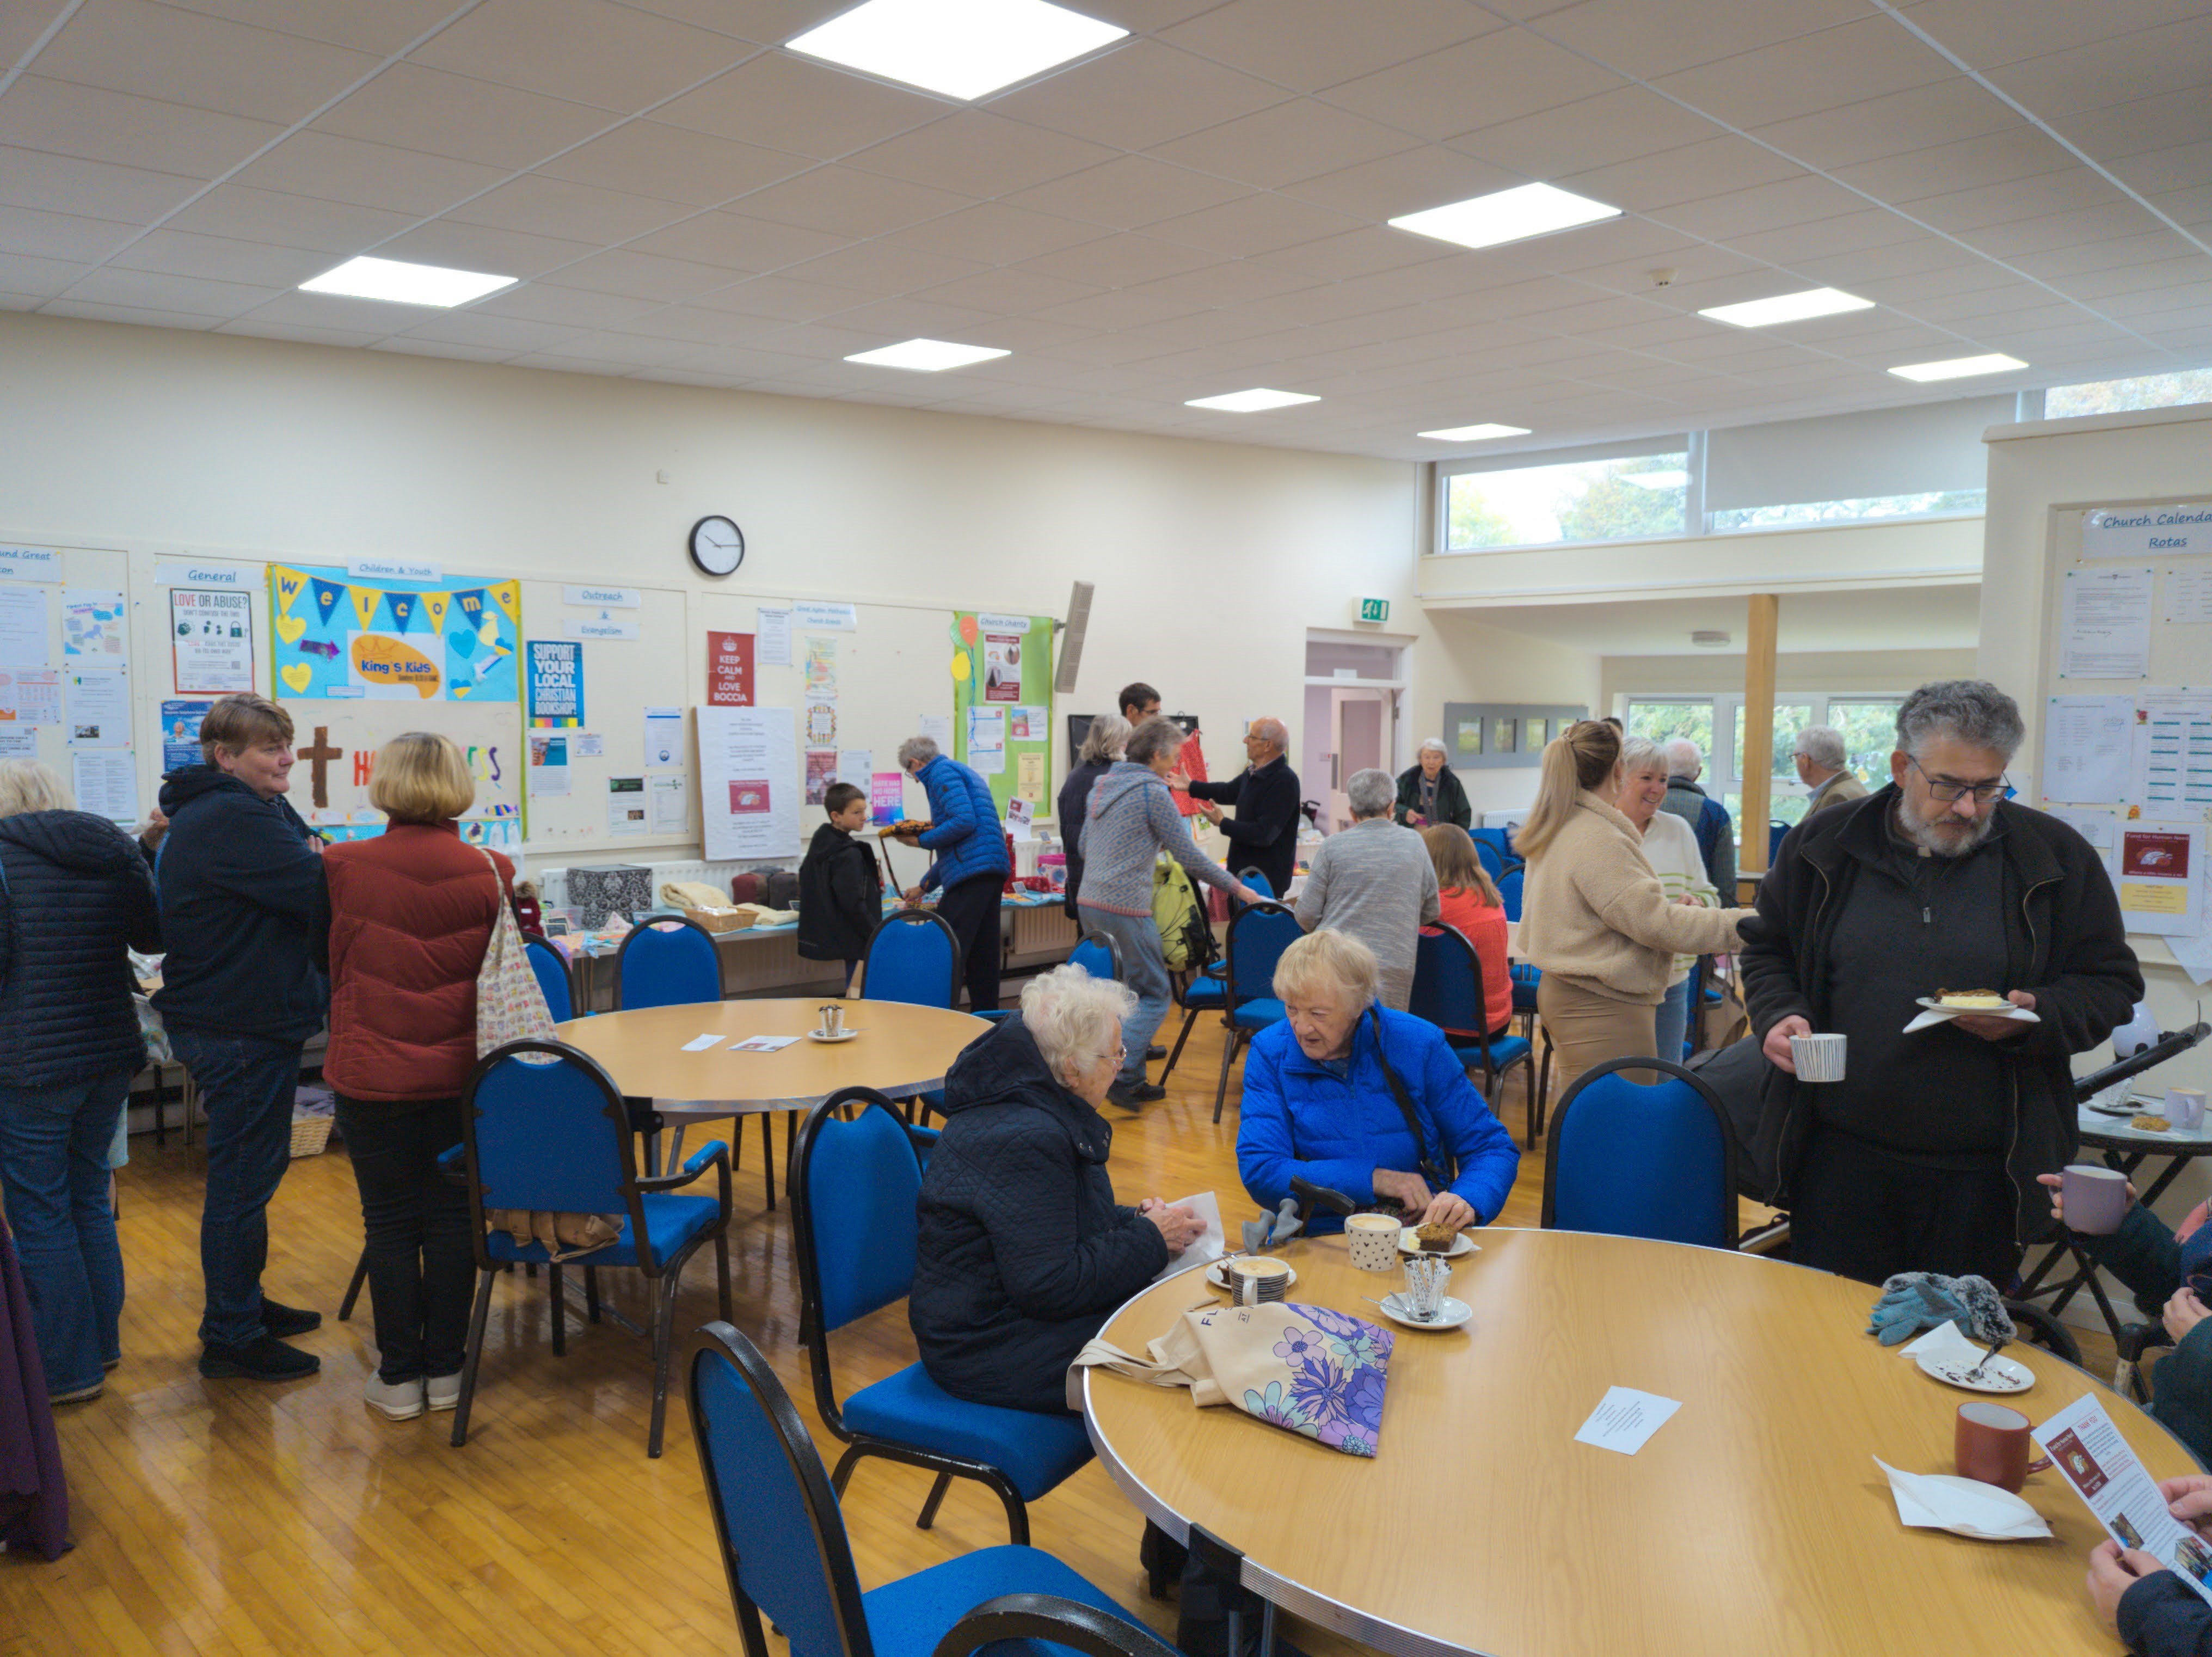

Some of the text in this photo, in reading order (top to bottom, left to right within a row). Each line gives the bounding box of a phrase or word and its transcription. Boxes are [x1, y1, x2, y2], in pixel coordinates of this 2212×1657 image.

[2103, 515, 2151, 527] Church
[2149, 537, 2187, 547] Rotas
[22, 551, 51, 560] Great
[360, 563, 394, 573] Children
[188, 570, 236, 582] General
[174, 593, 248, 609] LOVE OR ABUSE?
[582, 591, 623, 601] Outreach
[980, 618, 1027, 628] Church Charity
[581, 626, 622, 636] Evangelism
[533, 643, 575, 660] SUPPORT
[719, 655, 740, 664] KEEP
[534, 660, 575, 674] YOUR
[717, 665, 742, 675] CALM
[535, 674, 576, 688] LOCAL
[718, 682, 741, 691] LOVE
[536, 688, 576, 702] CHRISTIAN
[714, 692, 747, 702] BOCCIA
[873, 795, 901, 807] HERE
[2078, 1420, 2092, 1433] THANK
